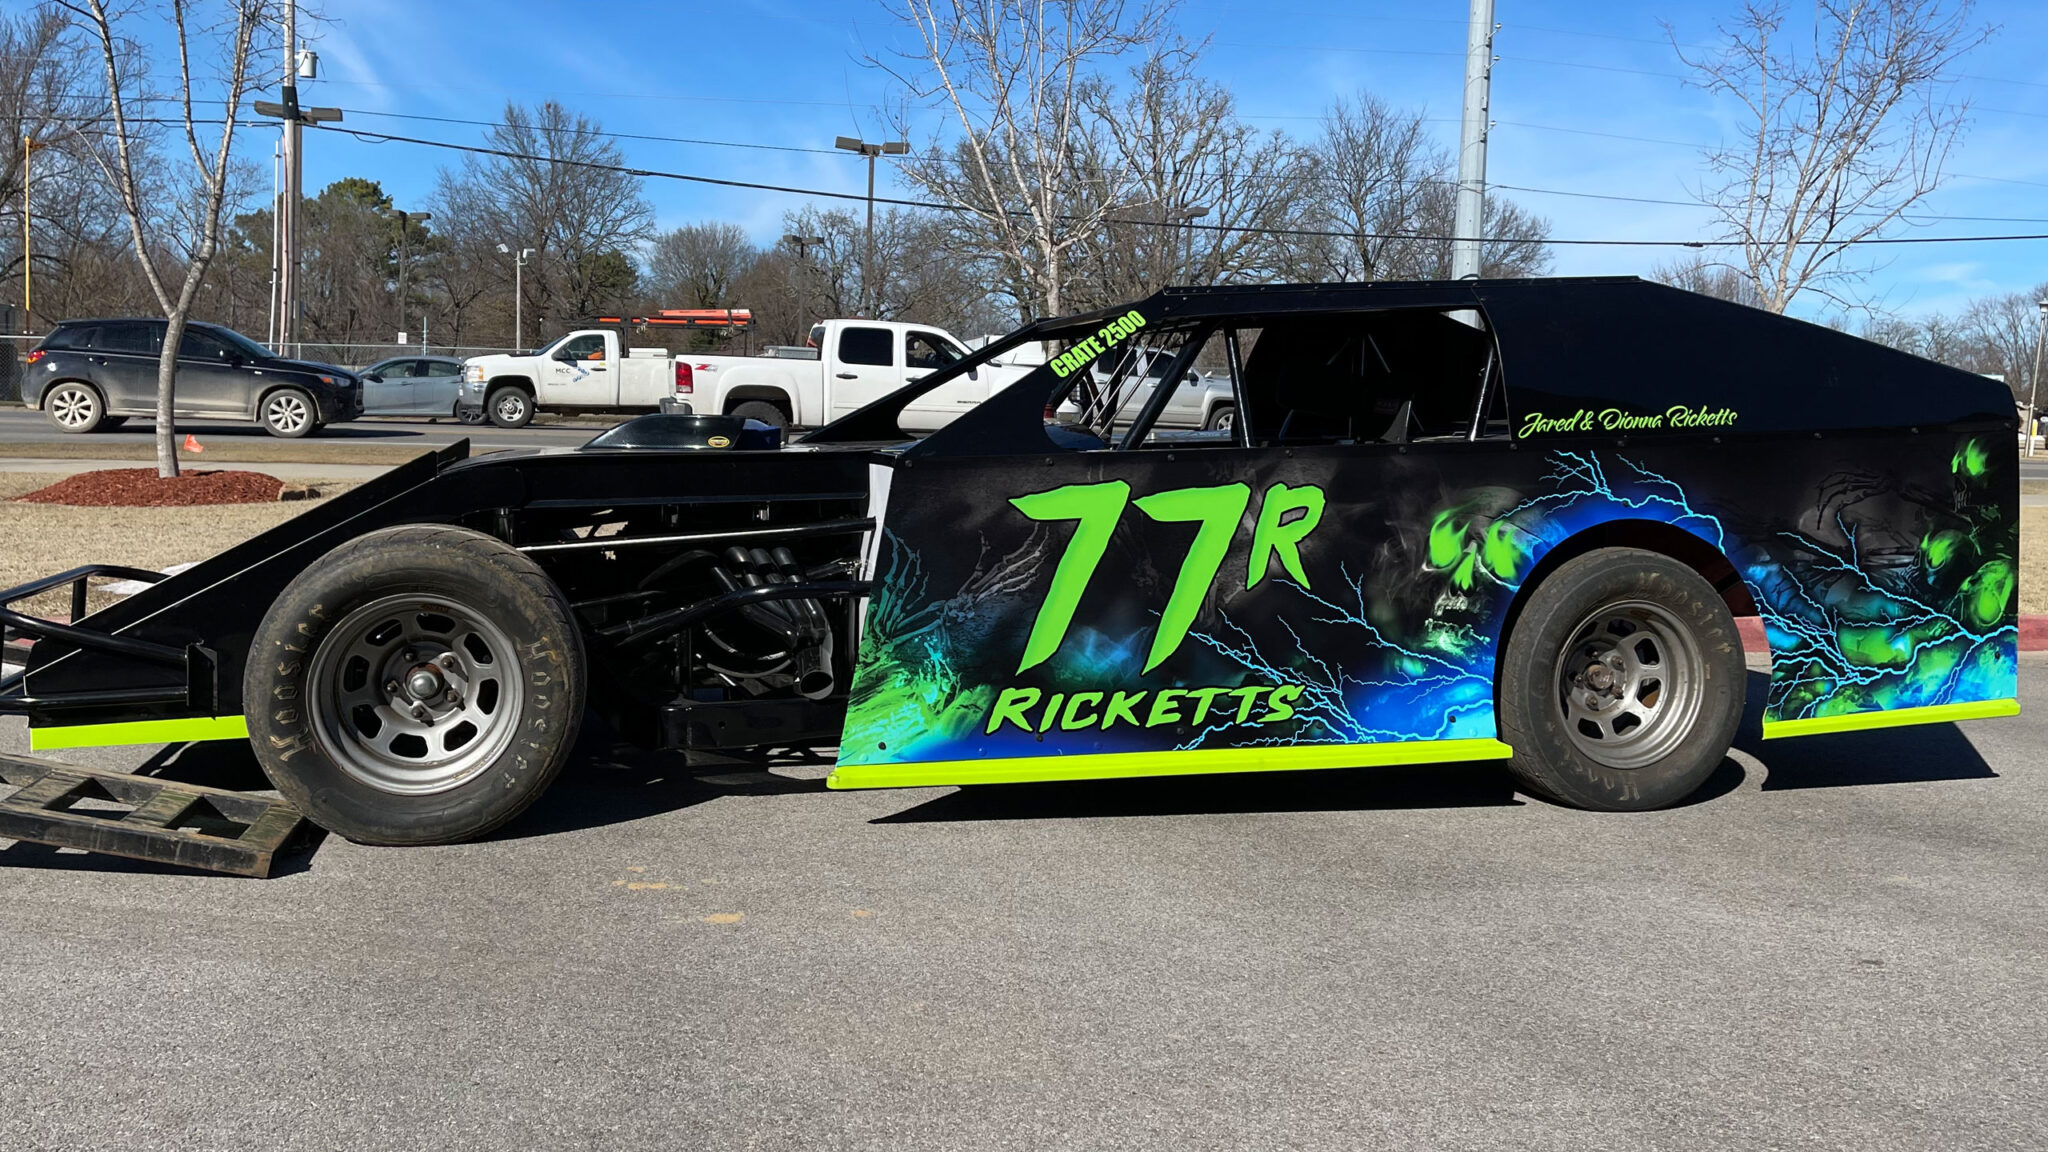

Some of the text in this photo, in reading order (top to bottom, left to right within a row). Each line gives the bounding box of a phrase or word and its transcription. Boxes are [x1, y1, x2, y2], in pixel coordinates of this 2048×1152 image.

[1049, 310, 1147, 378] CRATE 2500
[1518, 405, 1738, 439] Jared & Dionna Ricketts
[269, 603, 327, 762] Hoosier
[985, 684, 1306, 735] RICKETTS
